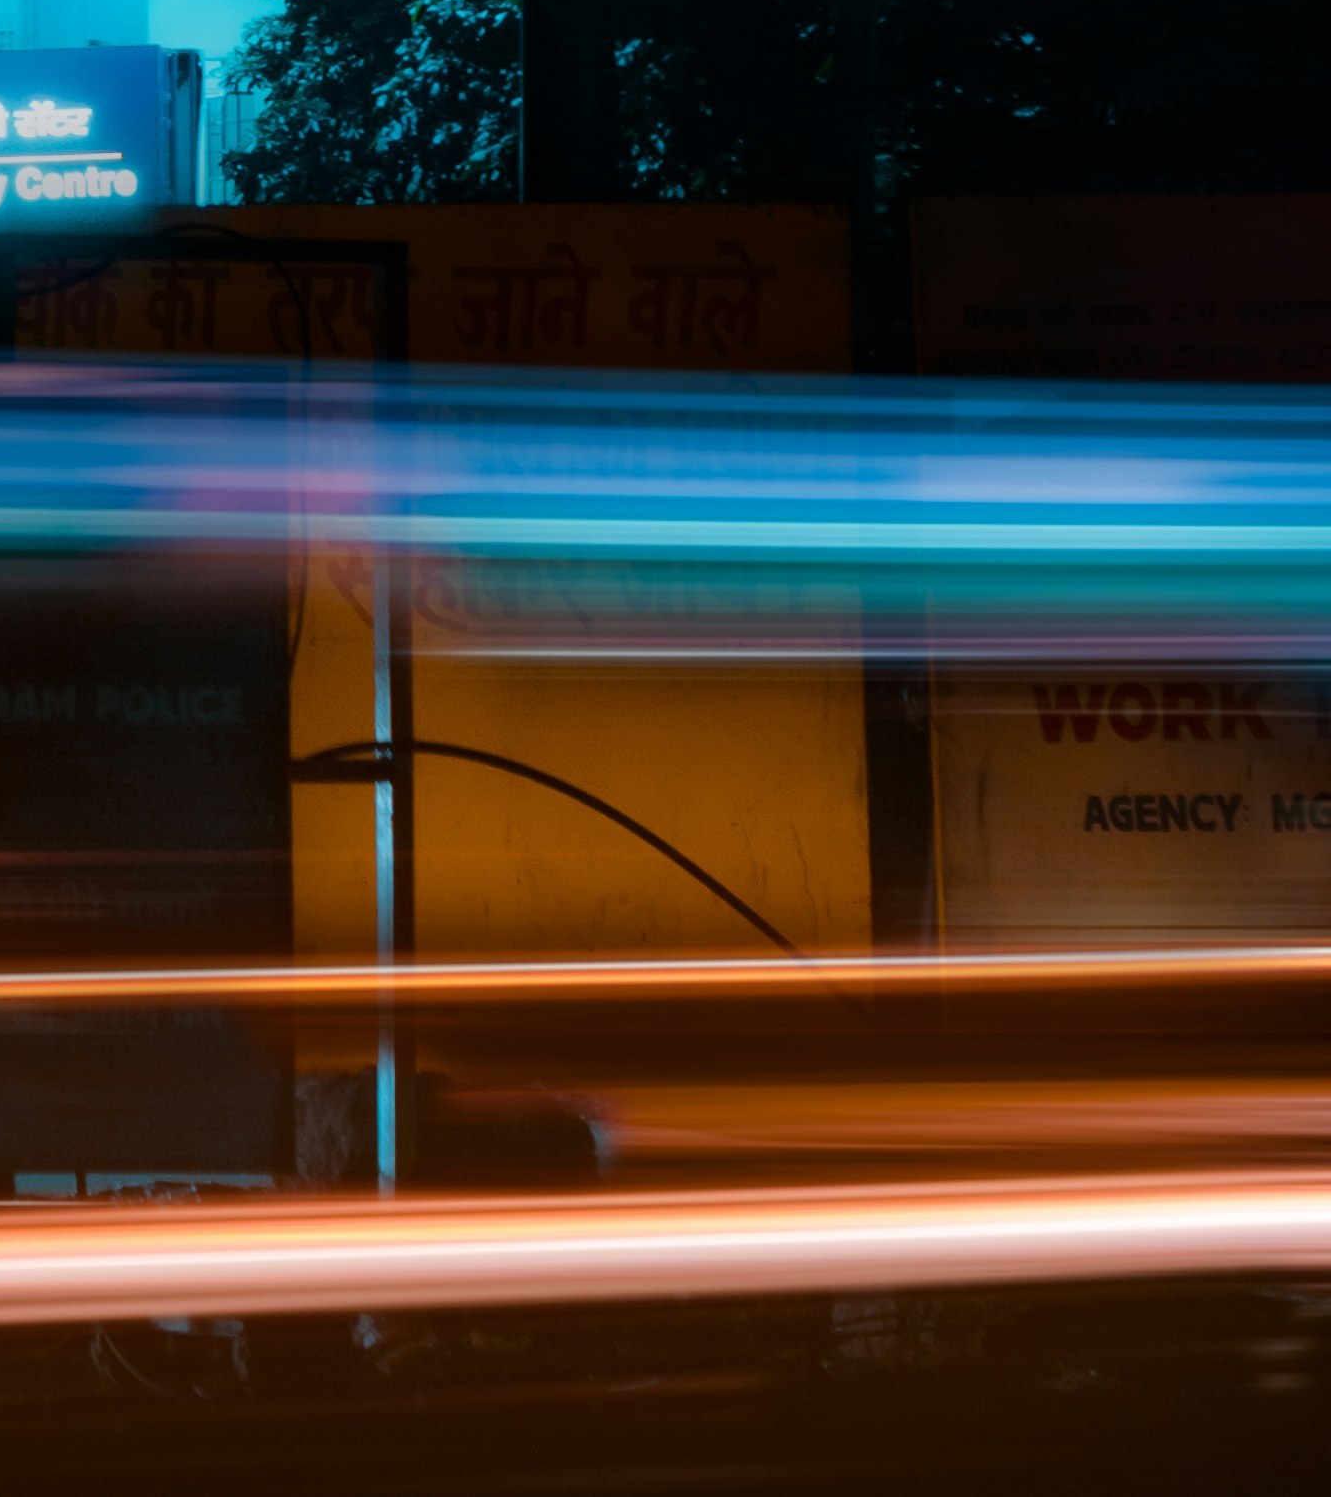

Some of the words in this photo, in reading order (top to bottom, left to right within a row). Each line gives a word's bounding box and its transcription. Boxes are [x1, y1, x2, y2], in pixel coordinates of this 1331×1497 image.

[451, 241, 601, 352] जाने
[628, 237, 778, 357] वाले
[94, 681, 244, 726] POLICE
[1031, 681, 1276, 745] WORK
